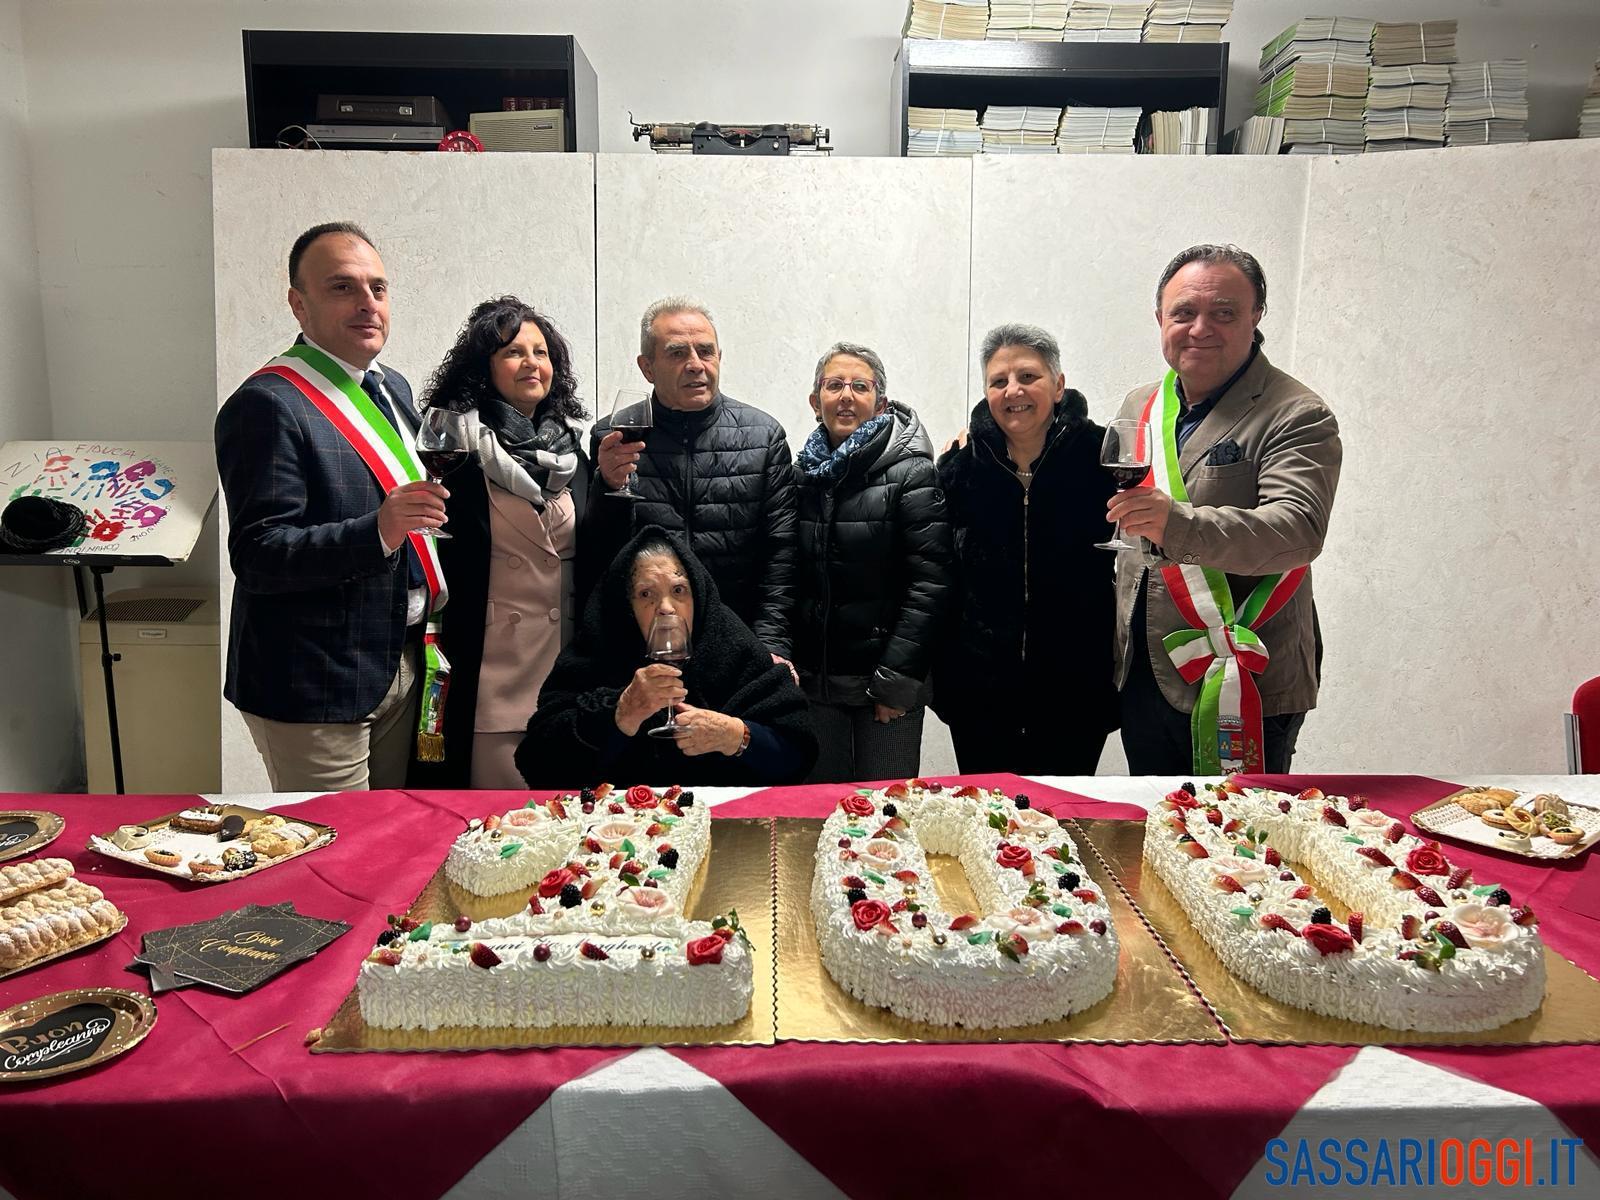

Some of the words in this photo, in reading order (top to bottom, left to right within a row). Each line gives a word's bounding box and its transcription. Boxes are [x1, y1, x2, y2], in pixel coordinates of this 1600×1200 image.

[233, 930, 284, 947] Buon
[0, 1021, 84, 1056] Buon
[4, 1017, 111, 1070] Compleanno
